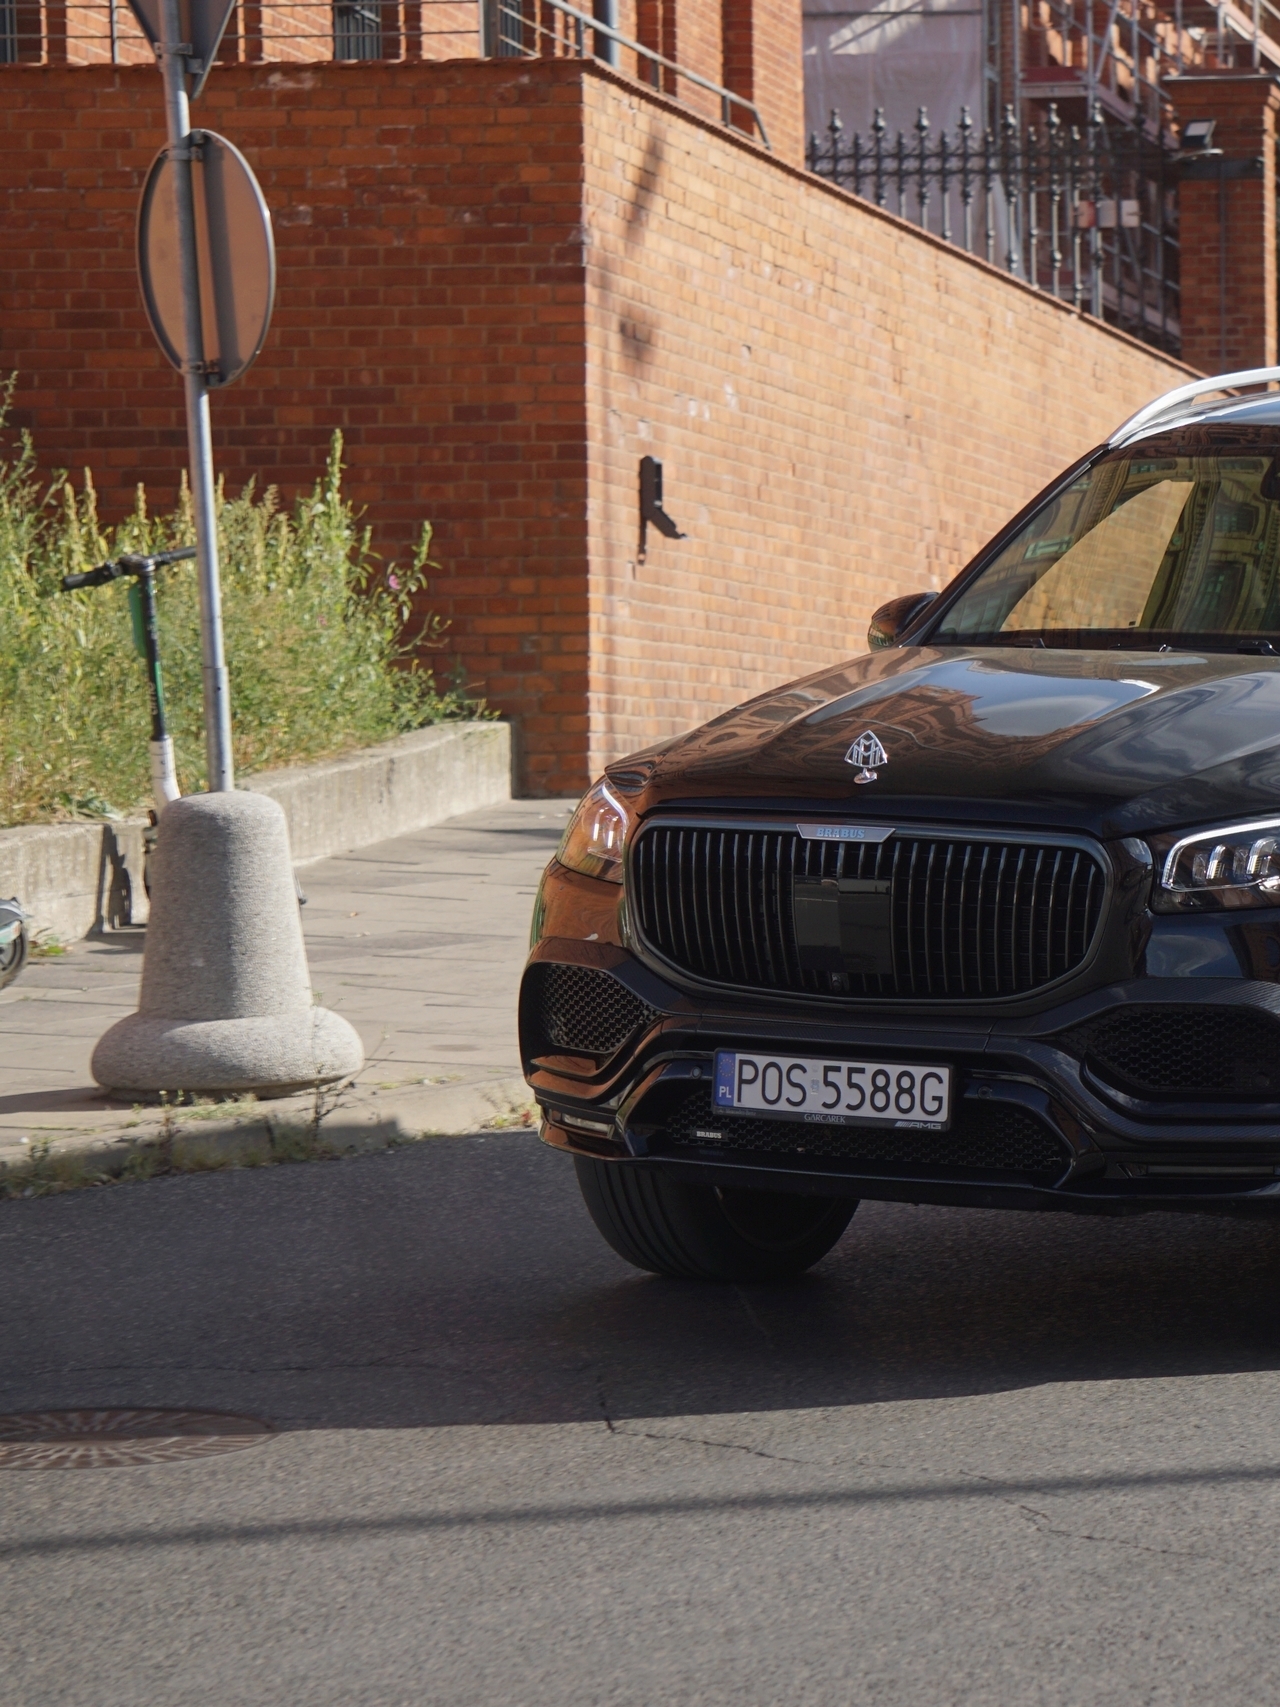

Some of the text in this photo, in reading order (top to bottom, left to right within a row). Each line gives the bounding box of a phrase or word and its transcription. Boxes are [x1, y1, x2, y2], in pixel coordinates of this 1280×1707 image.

[816, 827, 866, 839] BRABUS
[719, 1086, 732, 1098] PL
[737, 1059, 944, 1116] POS 5588G
[803, 1112, 846, 1124] GARCAREK
[696, 1131, 722, 1139] BRABUS
